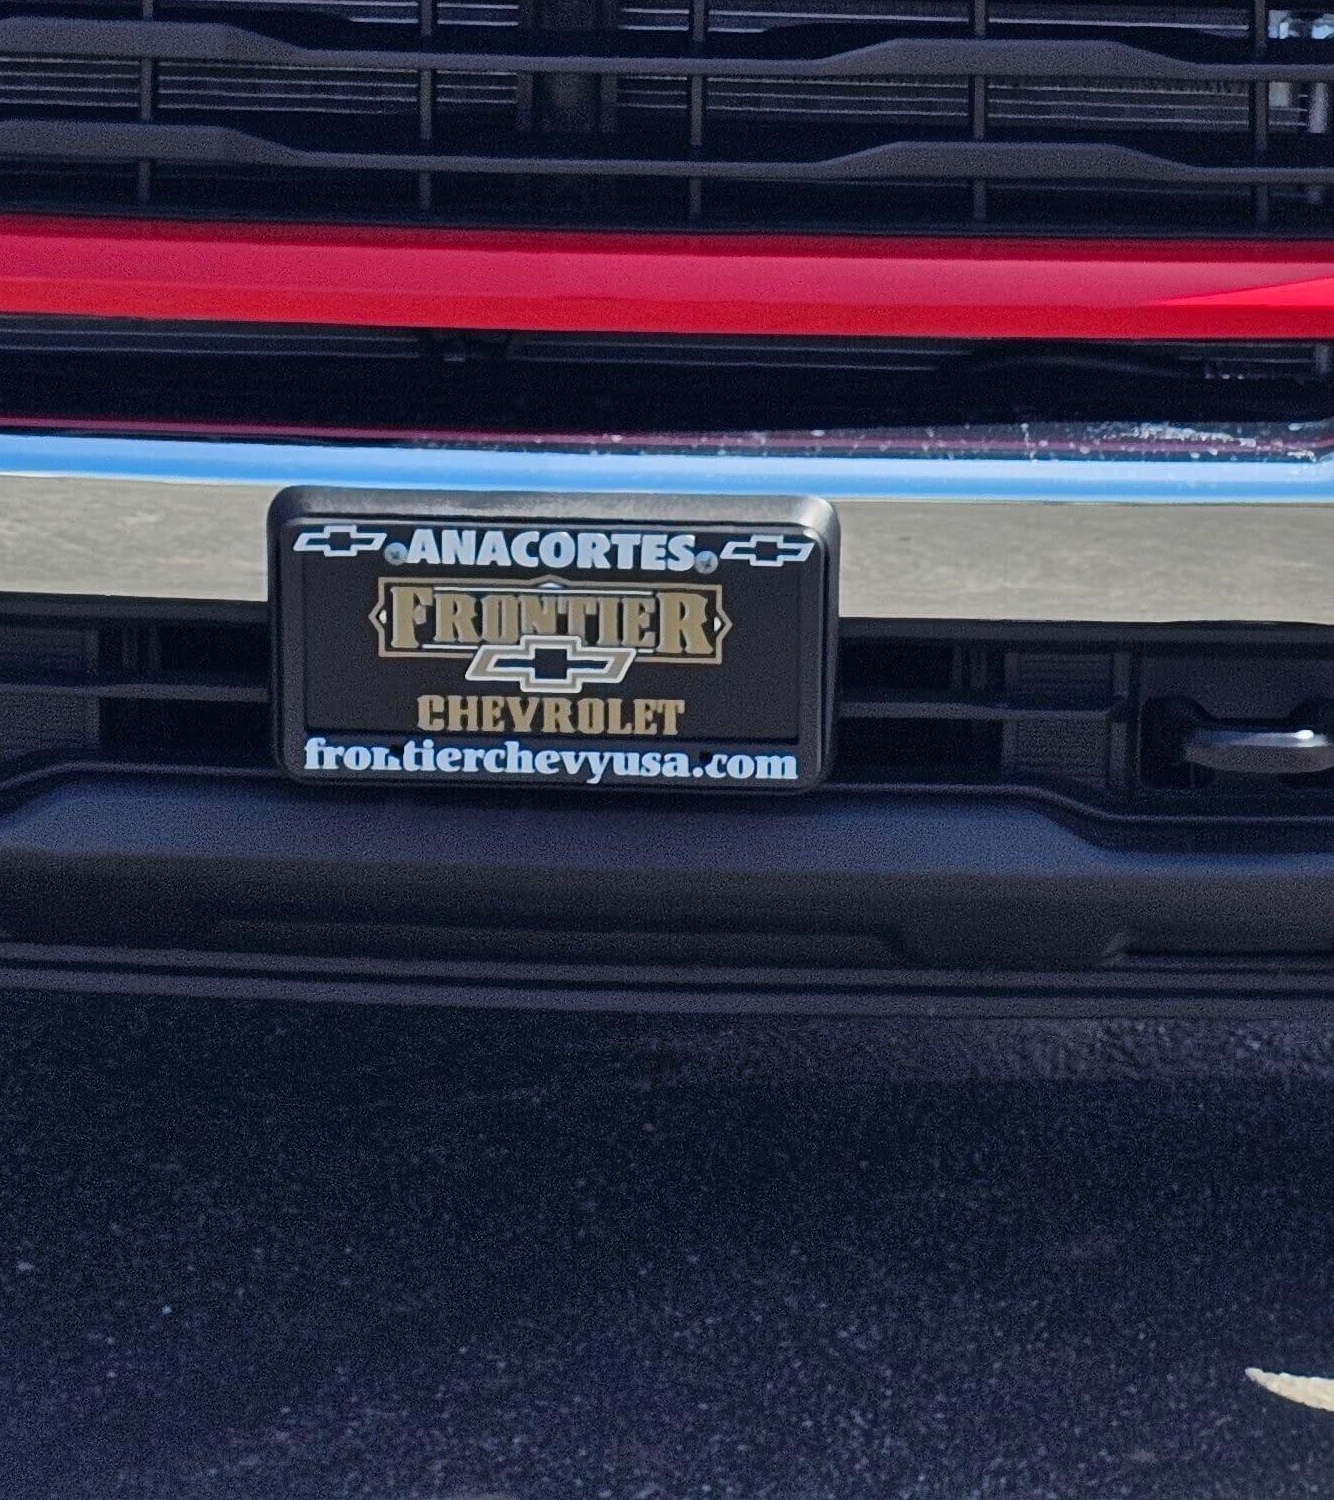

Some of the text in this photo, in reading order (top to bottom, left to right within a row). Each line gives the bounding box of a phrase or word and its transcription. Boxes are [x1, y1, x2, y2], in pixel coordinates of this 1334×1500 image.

[406, 528, 696, 571] ANACORTES
[390, 586, 714, 654] FRONTIER
[417, 695, 685, 735] CHEVROLET
[303, 737, 798, 784] frontierchevyusa.com
